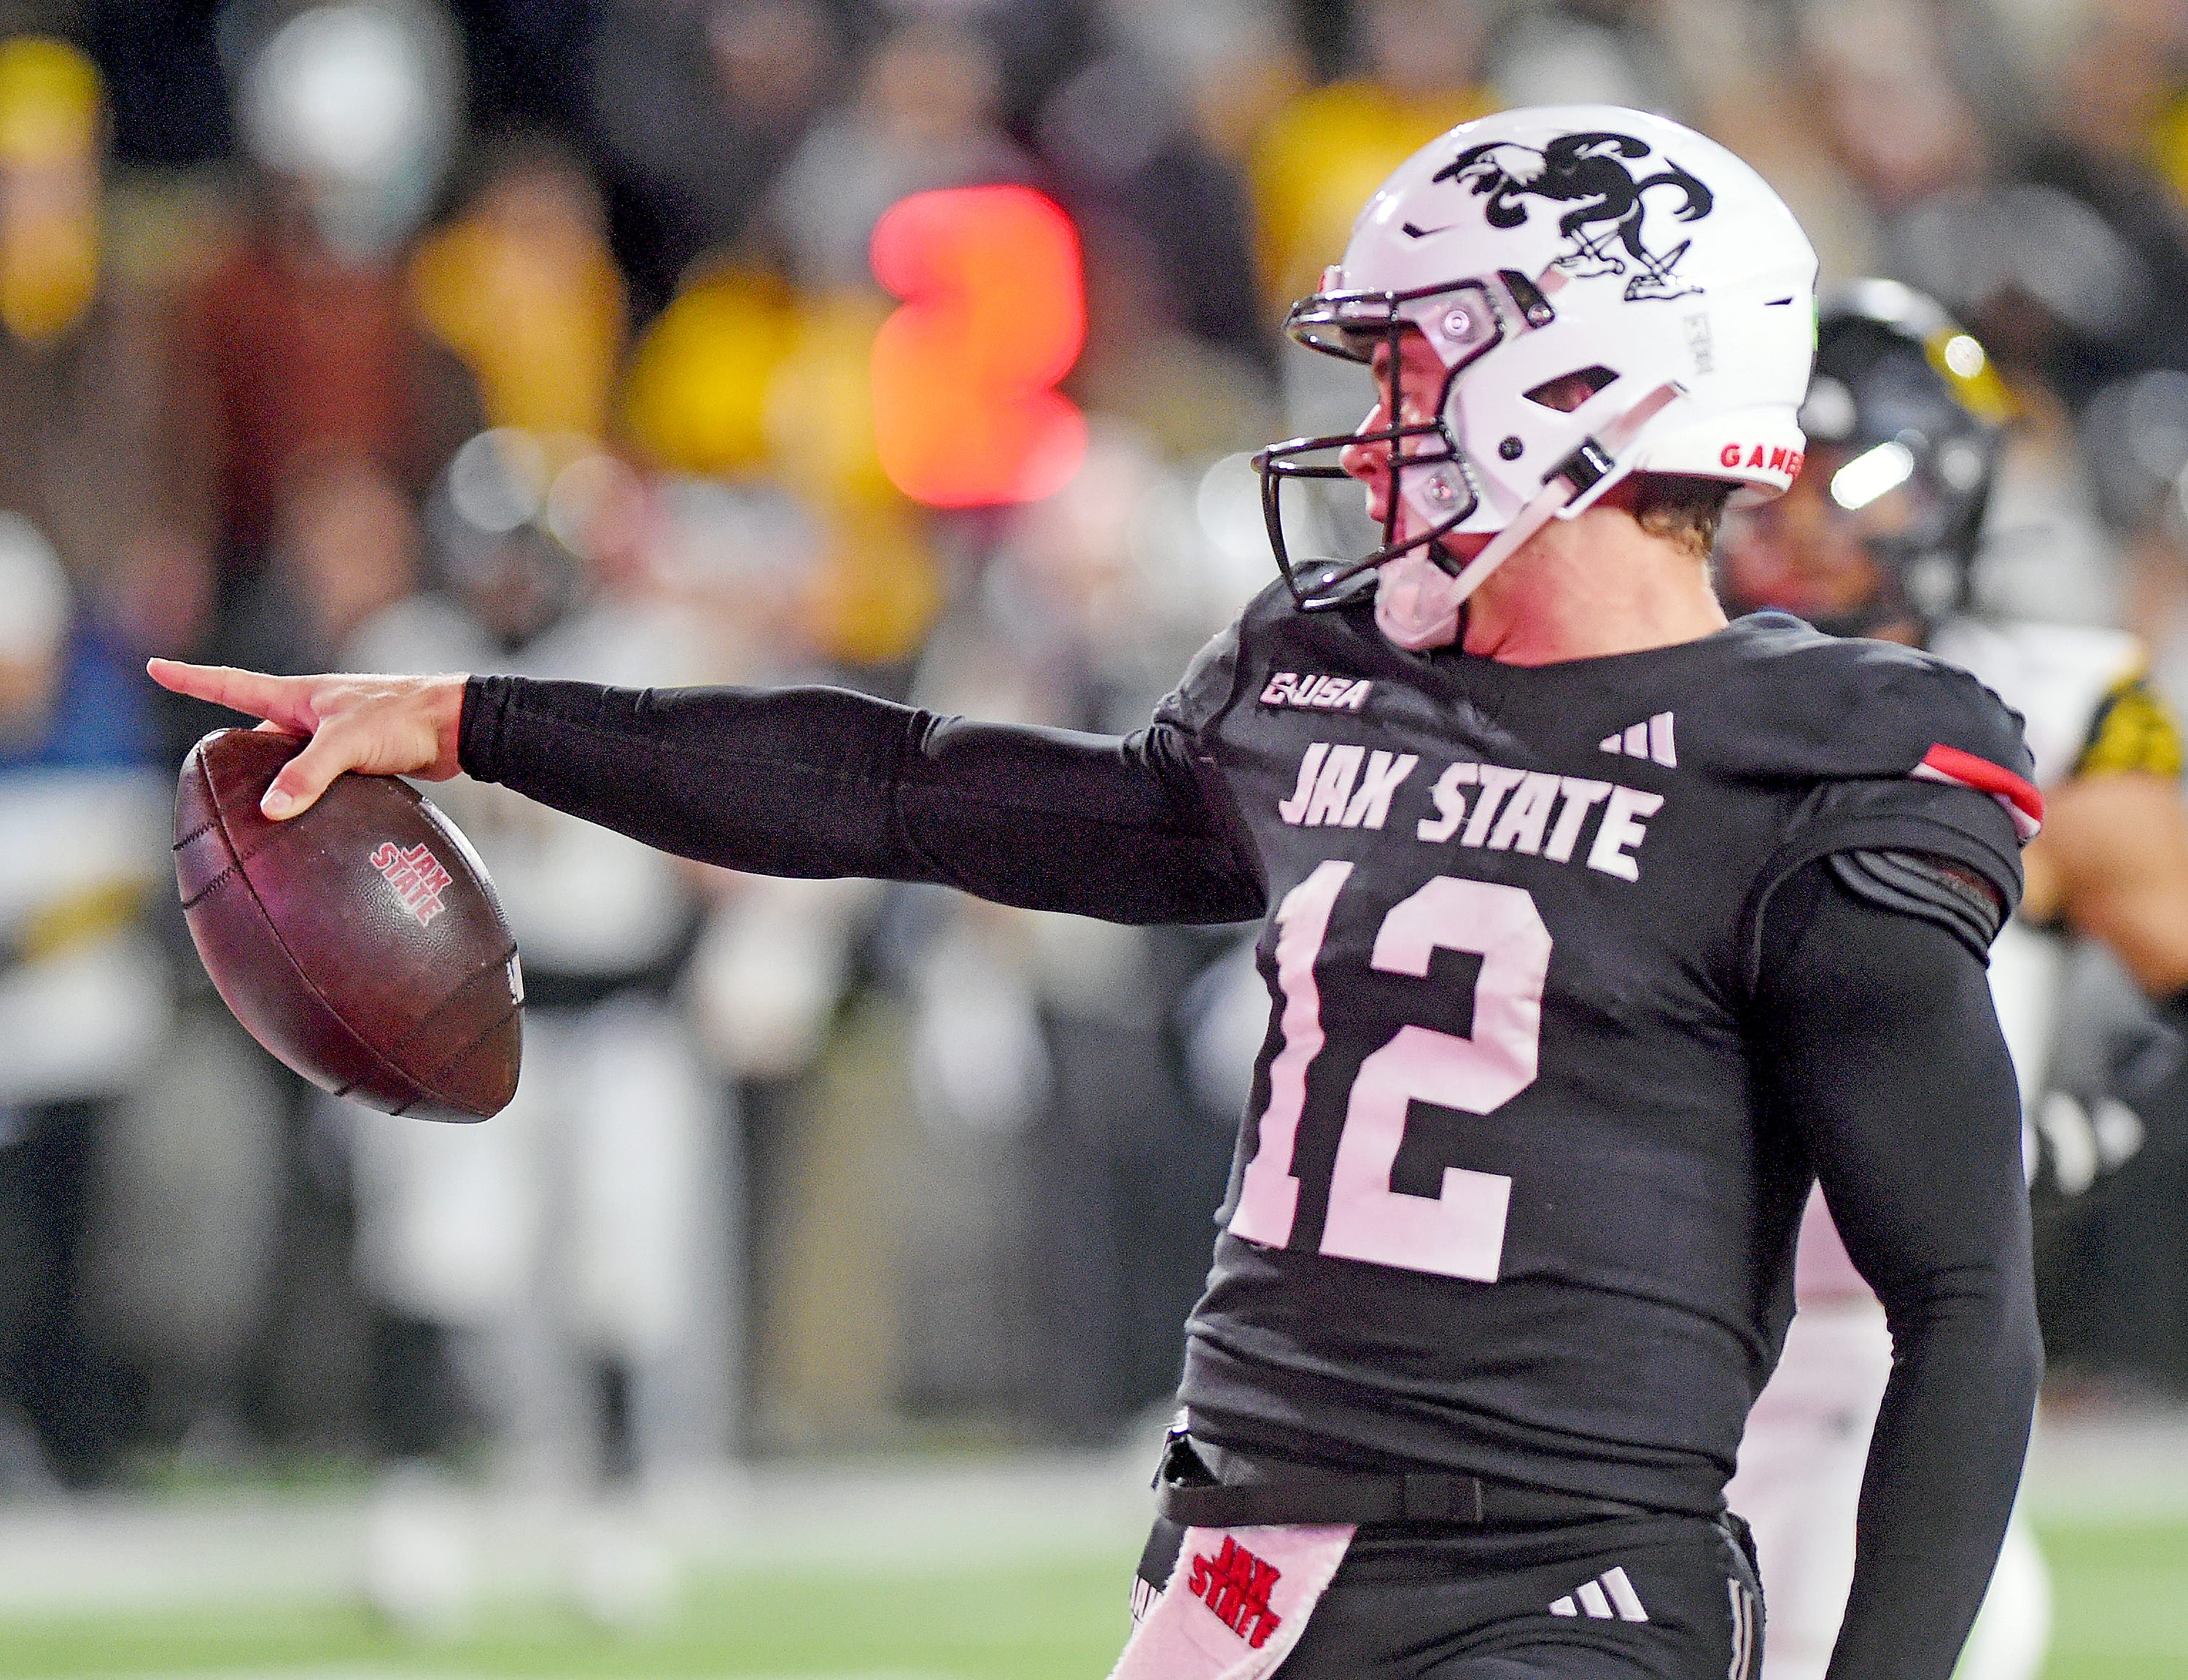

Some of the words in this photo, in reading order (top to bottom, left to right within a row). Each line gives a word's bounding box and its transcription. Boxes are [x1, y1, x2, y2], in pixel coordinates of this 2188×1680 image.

[1279, 742, 1419, 830] JAX
[1417, 761, 1664, 883] STATE
[371, 841, 446, 928] STATE
[401, 842, 453, 896] JAX
[1227, 860, 1553, 1283] 12
[1188, 1554, 1282, 1649] STATE
[1211, 1534, 1281, 1606] JAX
